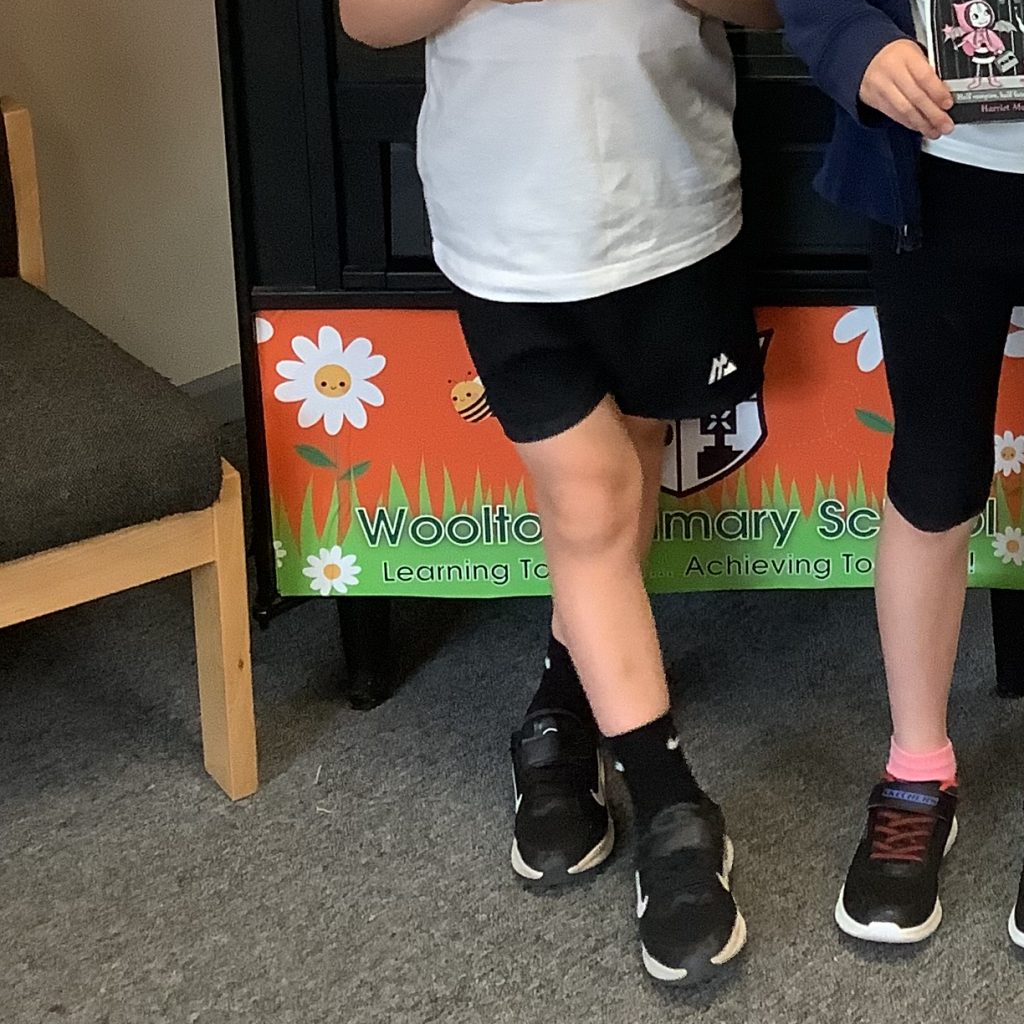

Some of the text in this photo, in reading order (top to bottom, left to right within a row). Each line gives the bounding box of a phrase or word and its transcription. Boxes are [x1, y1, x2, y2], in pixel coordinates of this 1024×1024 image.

[981, 103, 1010, 113] Harriet
[357, 505, 543, 547] Woolto
[383, 560, 509, 585] Learning
[685, 553, 831, 577] Achieving
